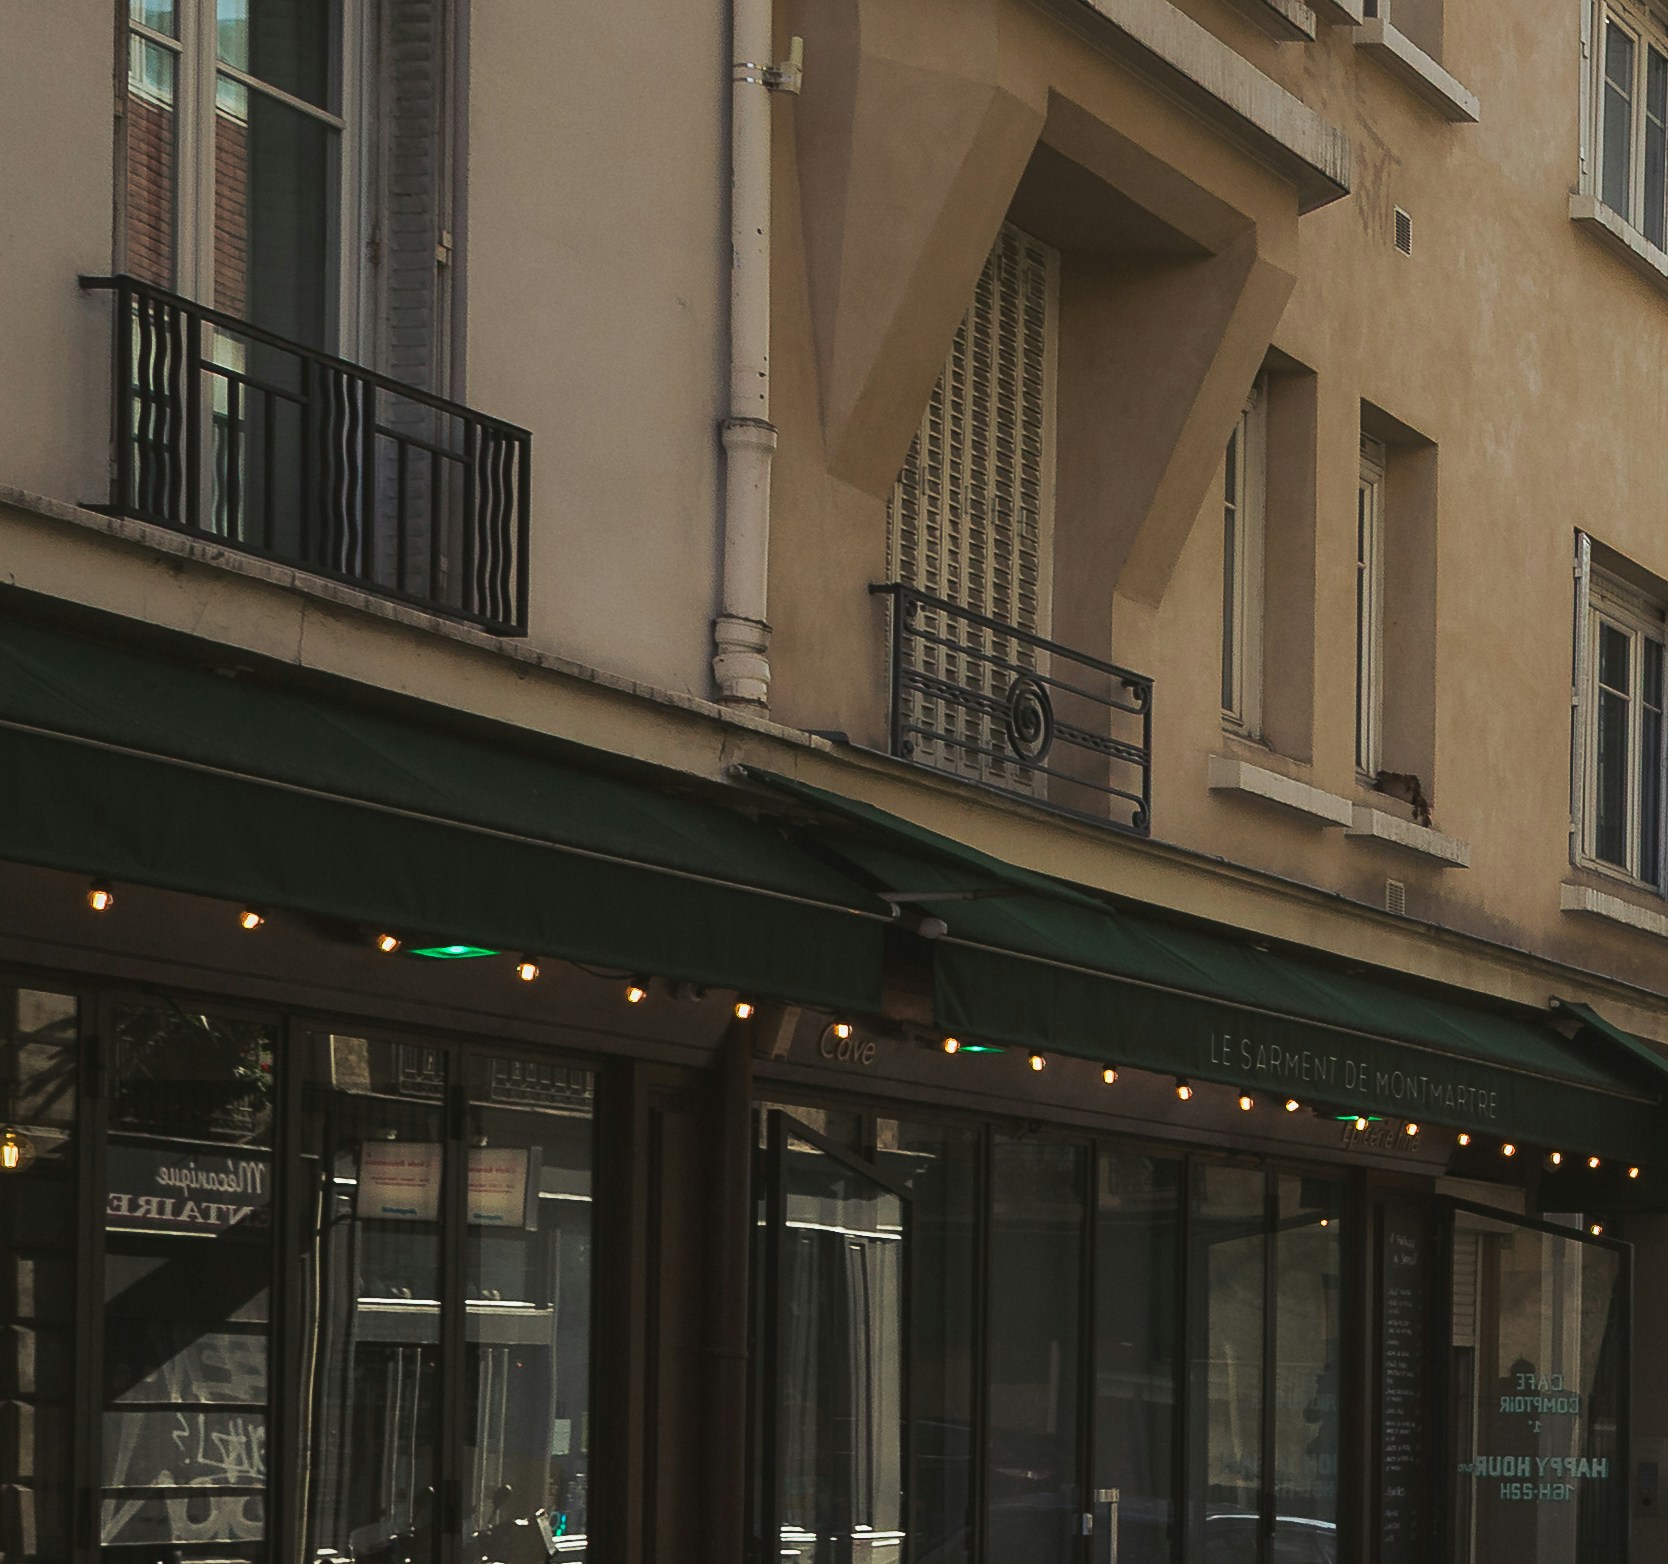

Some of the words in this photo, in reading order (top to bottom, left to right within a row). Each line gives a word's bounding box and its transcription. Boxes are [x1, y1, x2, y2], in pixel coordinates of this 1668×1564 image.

[819, 1022, 876, 1065] Cave
[1210, 1033, 1231, 1067] LE
[1240, 1038, 1338, 1086] SARMENT
[1345, 1060, 1369, 1093] DE
[1377, 1070, 1497, 1120] MONTMARTRE
